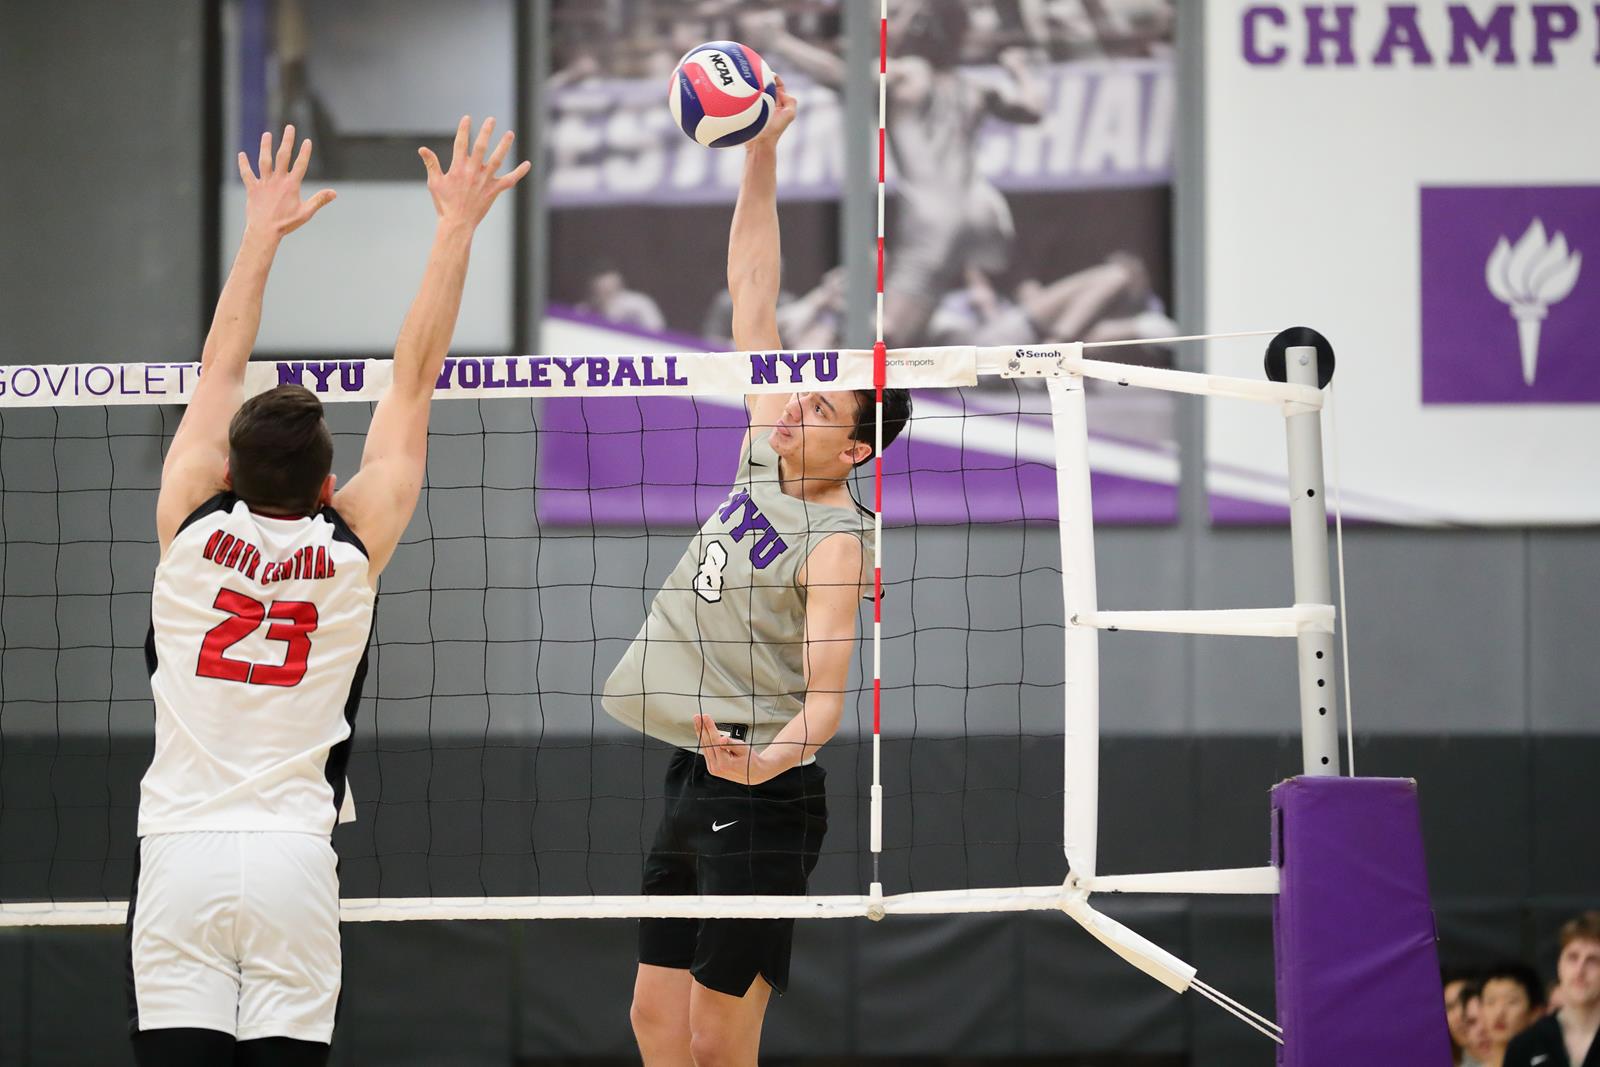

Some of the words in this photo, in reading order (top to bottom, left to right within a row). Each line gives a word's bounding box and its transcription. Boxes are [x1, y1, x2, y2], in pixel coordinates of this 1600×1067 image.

[1242, 5, 1600, 65] CHAMP
[709, 53, 734, 86] NCAA
[884, 359, 905, 367] ports
[1026, 350, 1061, 358] Senoh
[0, 364, 202, 397] OVIOLET
[276, 361, 365, 392] NYU
[434, 355, 688, 389] VOLLEYBALL
[750, 352, 839, 385] NYU
[196, 587, 319, 687] 23
